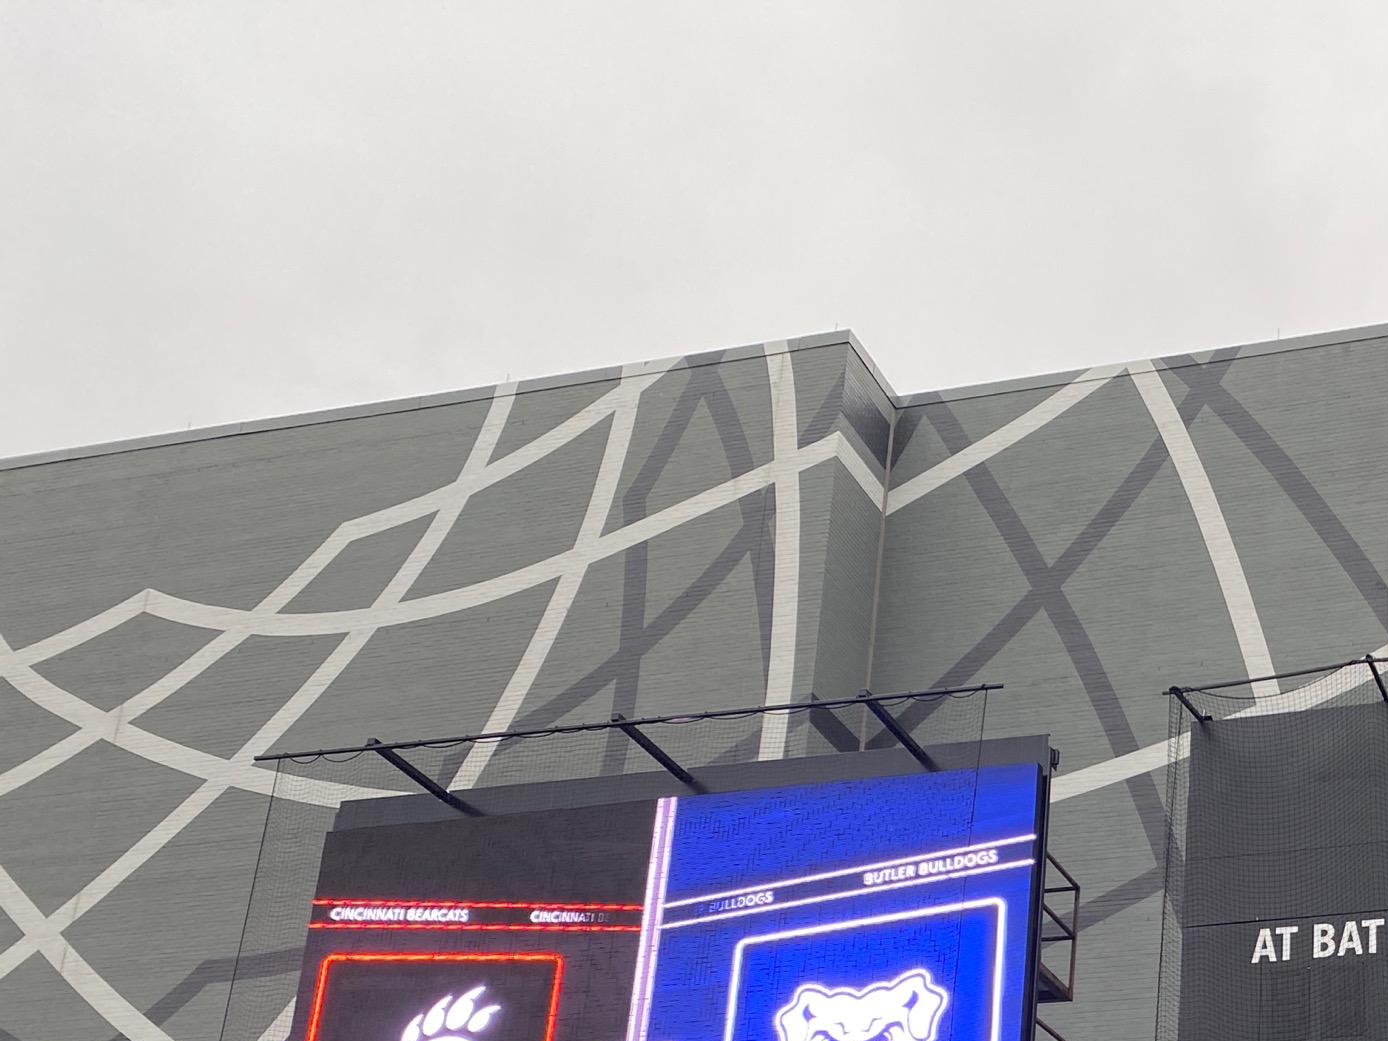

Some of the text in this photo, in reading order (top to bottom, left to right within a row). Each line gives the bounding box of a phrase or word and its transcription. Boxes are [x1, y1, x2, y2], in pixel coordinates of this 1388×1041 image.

[862, 850, 997, 885] BUTLER BULLDOGS
[709, 892, 774, 912] BULLDOGS
[330, 906, 469, 922] CINCINNATI BEARCATS
[530, 910, 595, 923] CINCINNATI
[1251, 918, 1384, 963] AT BAT
